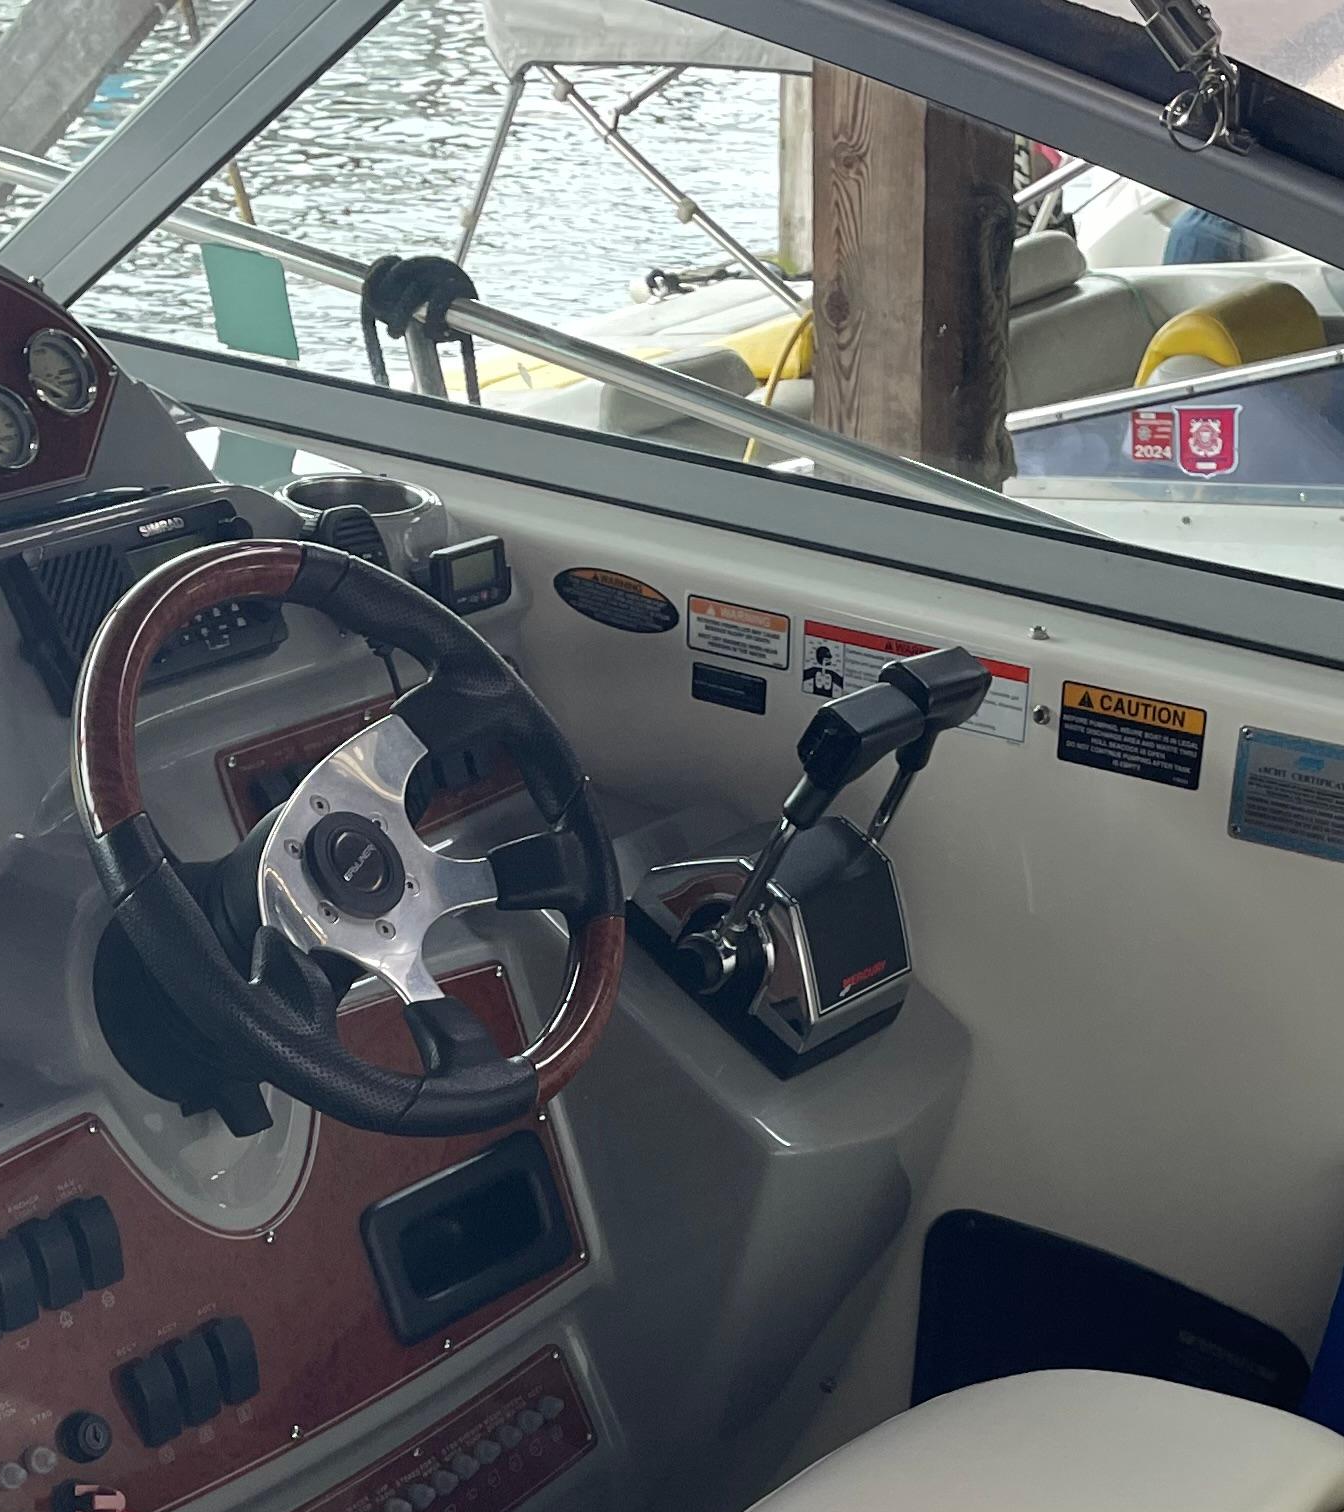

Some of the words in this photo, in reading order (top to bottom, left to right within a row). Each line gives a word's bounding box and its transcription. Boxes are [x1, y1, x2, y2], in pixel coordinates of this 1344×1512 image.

[1134, 444, 1172, 460] 2024
[138, 516, 185, 537] SIMRAD
[720, 606, 771, 628] WARNING
[1100, 694, 1186, 728] CAUTION
